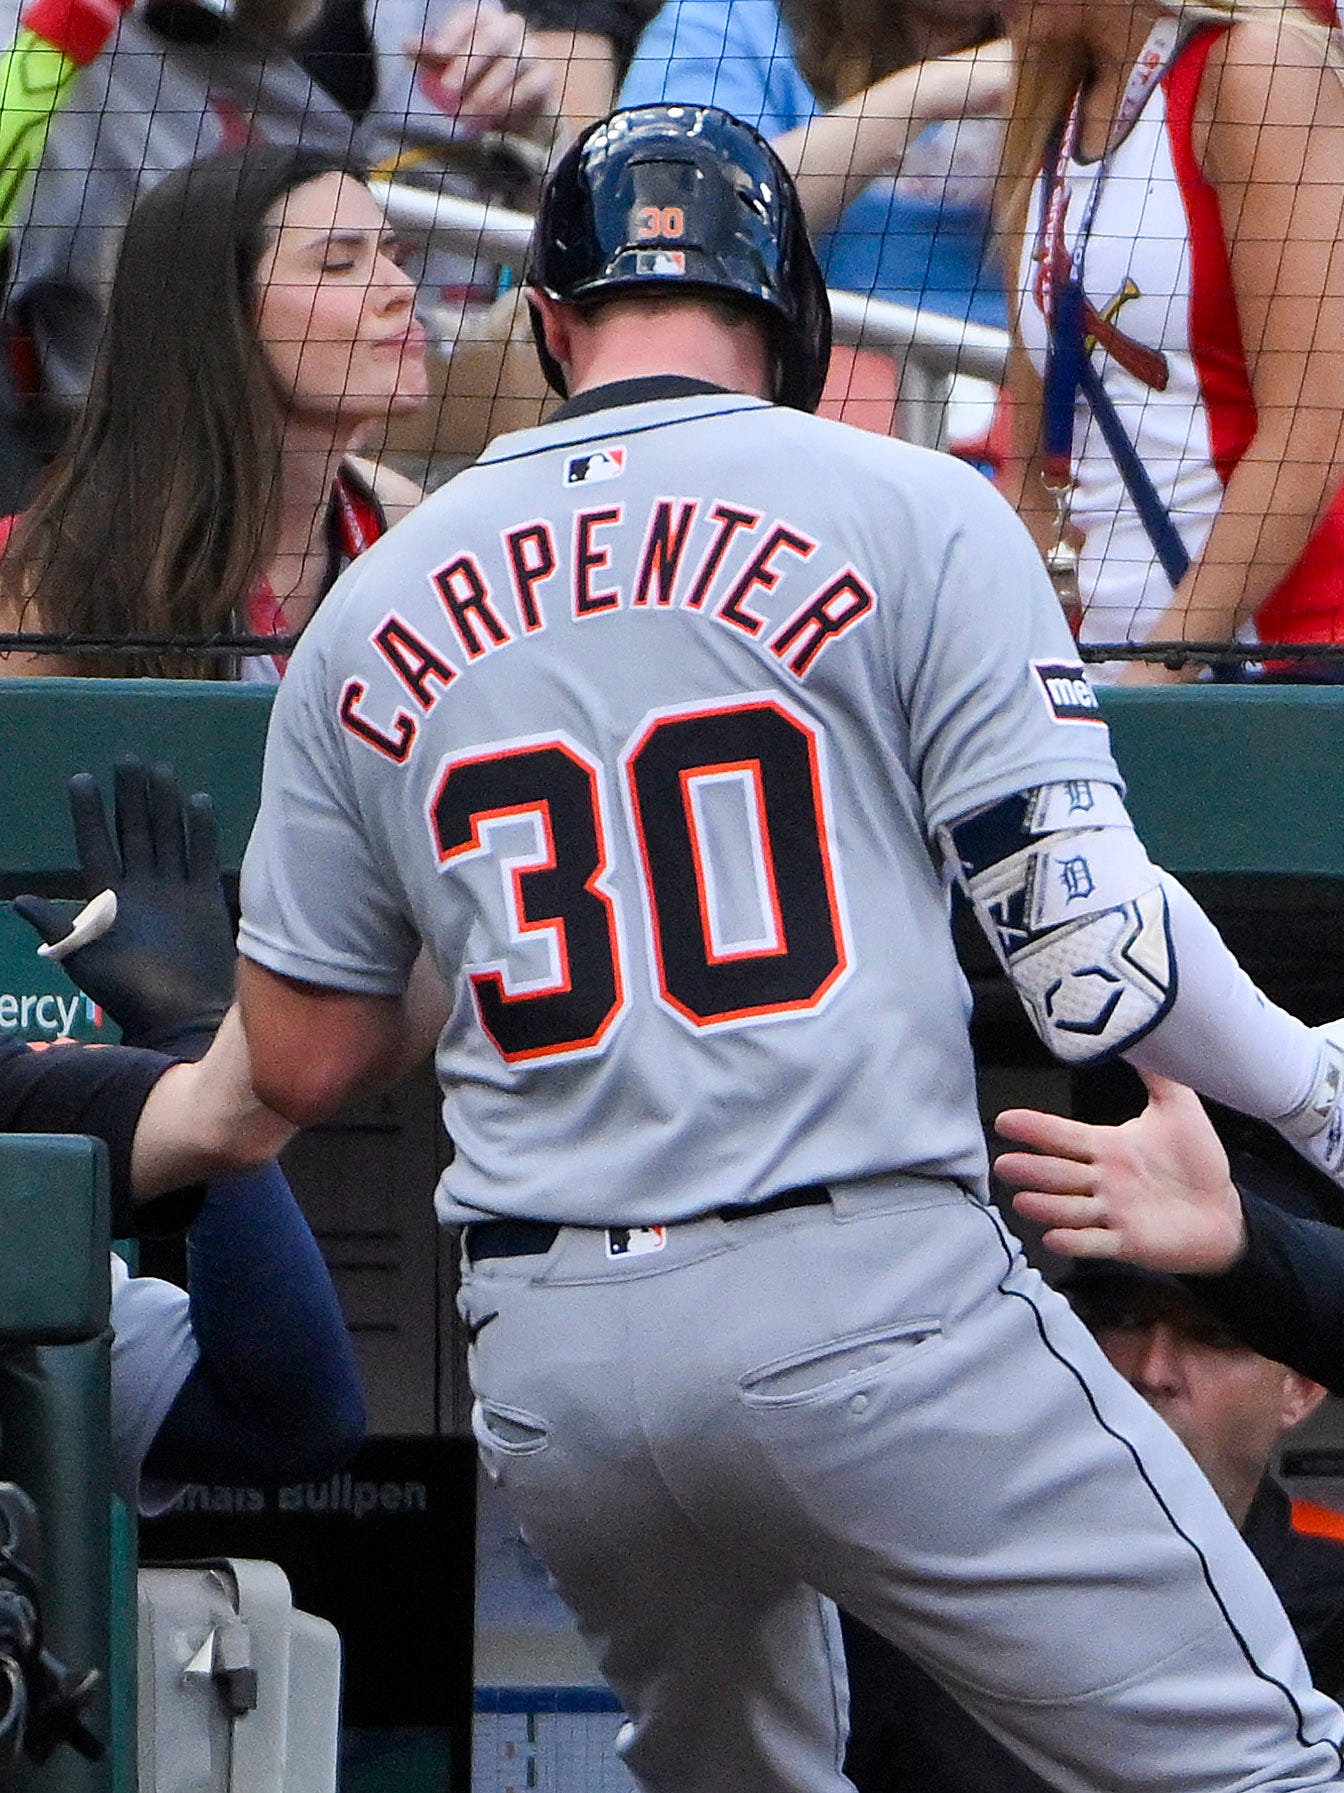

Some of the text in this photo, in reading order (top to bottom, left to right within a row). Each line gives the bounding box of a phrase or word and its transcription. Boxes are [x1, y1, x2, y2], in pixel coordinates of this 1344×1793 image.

[637, 207, 684, 238] 30
[338, 495, 876, 764] CARPENTER
[424, 690, 857, 1070] 30
[1055, 855, 1096, 905] D
